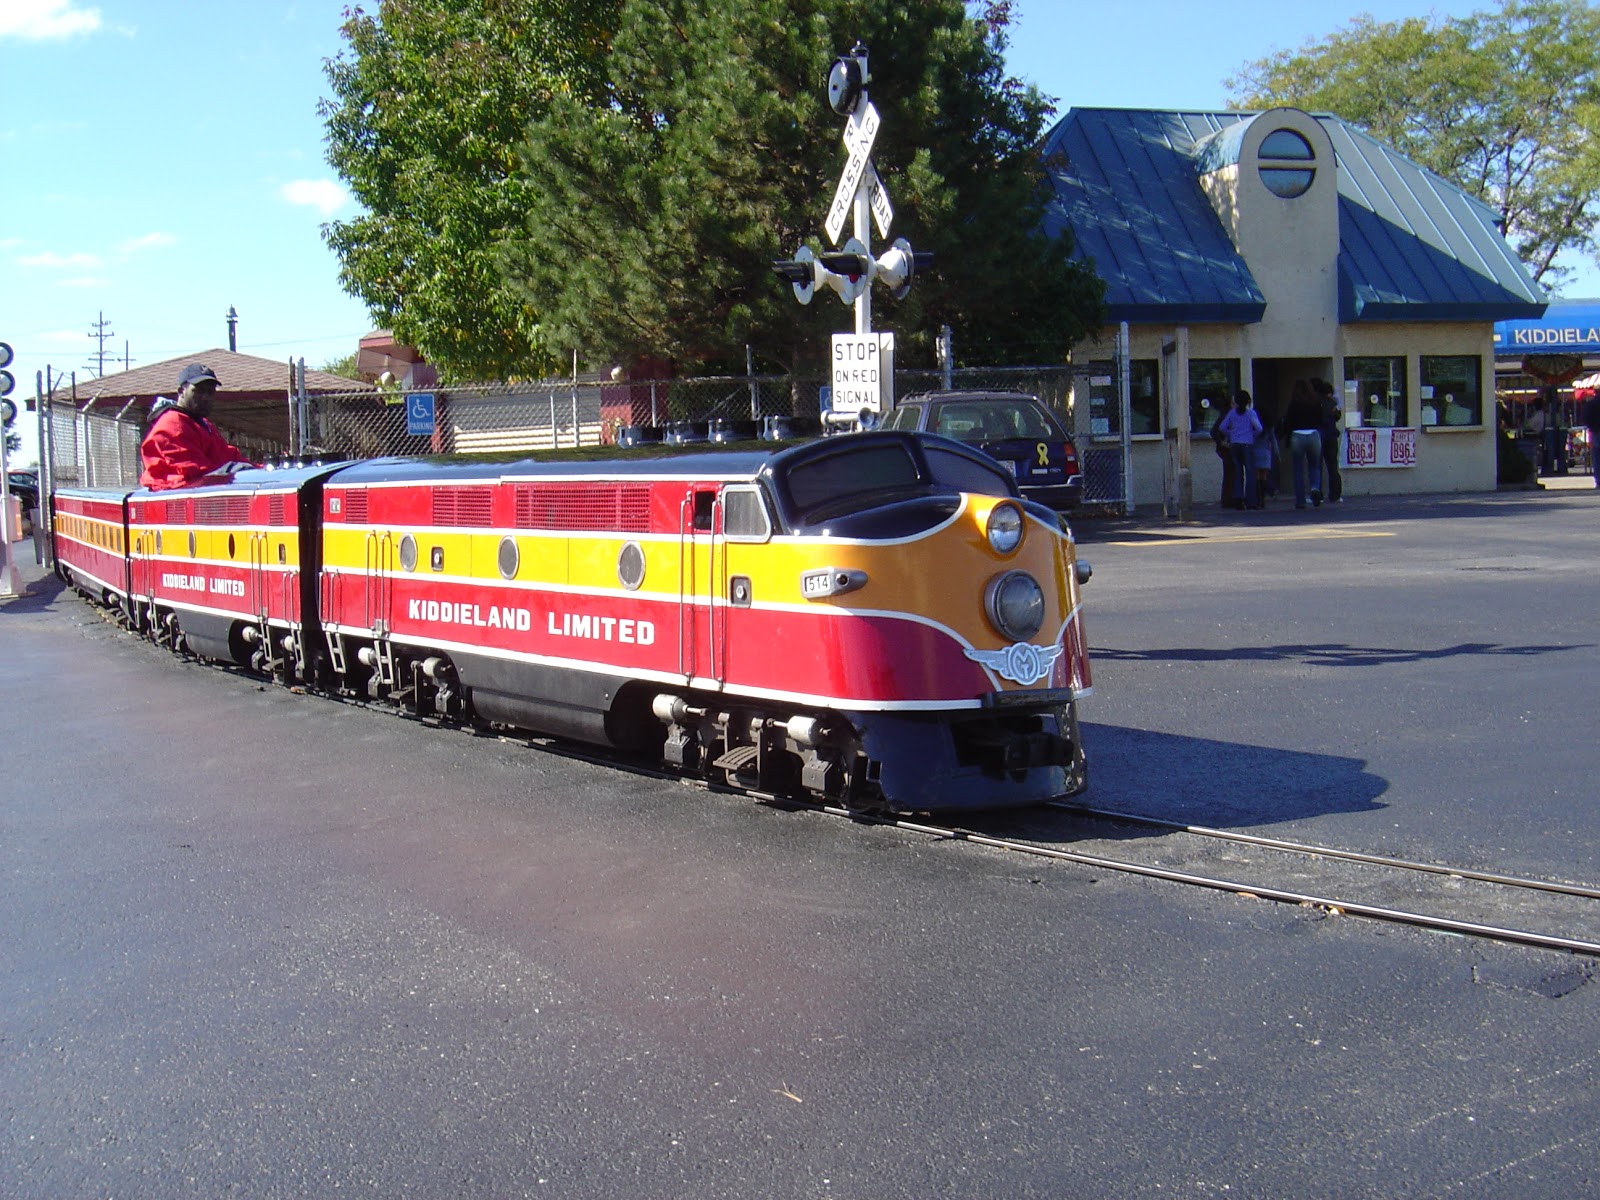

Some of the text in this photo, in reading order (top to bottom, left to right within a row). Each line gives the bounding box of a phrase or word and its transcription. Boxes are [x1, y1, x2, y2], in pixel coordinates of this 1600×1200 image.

[830, 117, 875, 231] CROSSING
[871, 181, 891, 231] ROAD
[1514, 328, 1600, 344] KIDDIELA
[835, 342, 877, 361] STOP
[835, 369, 877, 383] ON RED
[836, 390, 877, 404] SIGNAL
[1350, 443, 1373, 460] B96.3
[162, 573, 245, 597] KIDDIELAND LIMITED
[809, 576, 828, 591] 514
[408, 598, 655, 646] KIDDIELAND LIMITED
